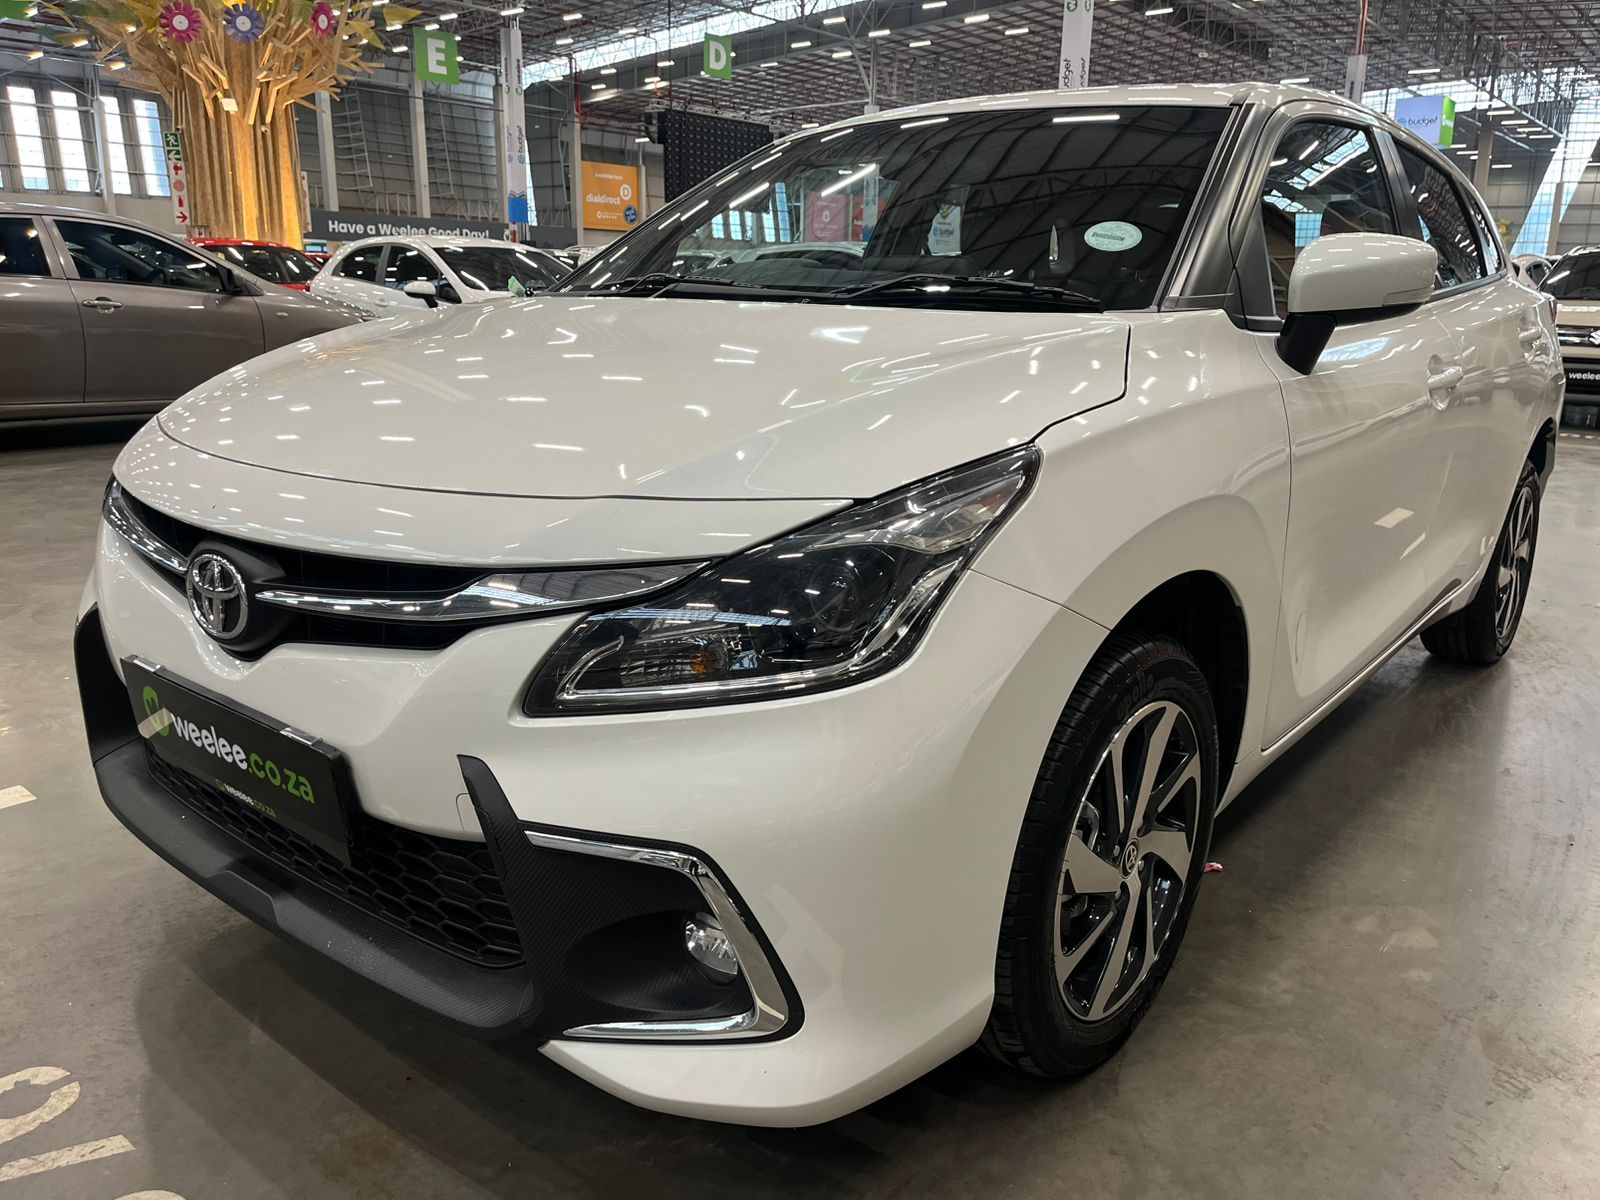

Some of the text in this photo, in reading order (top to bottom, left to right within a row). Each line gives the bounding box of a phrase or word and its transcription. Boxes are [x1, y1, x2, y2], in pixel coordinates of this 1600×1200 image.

[426, 38, 448, 75] E
[709, 41, 727, 71] D
[1408, 116, 1438, 127] budget
[586, 193, 621, 205] dialdirect
[328, 220, 490, 239] Have a Weelee Good Day!
[171, 713, 315, 804] weelee.co.za
